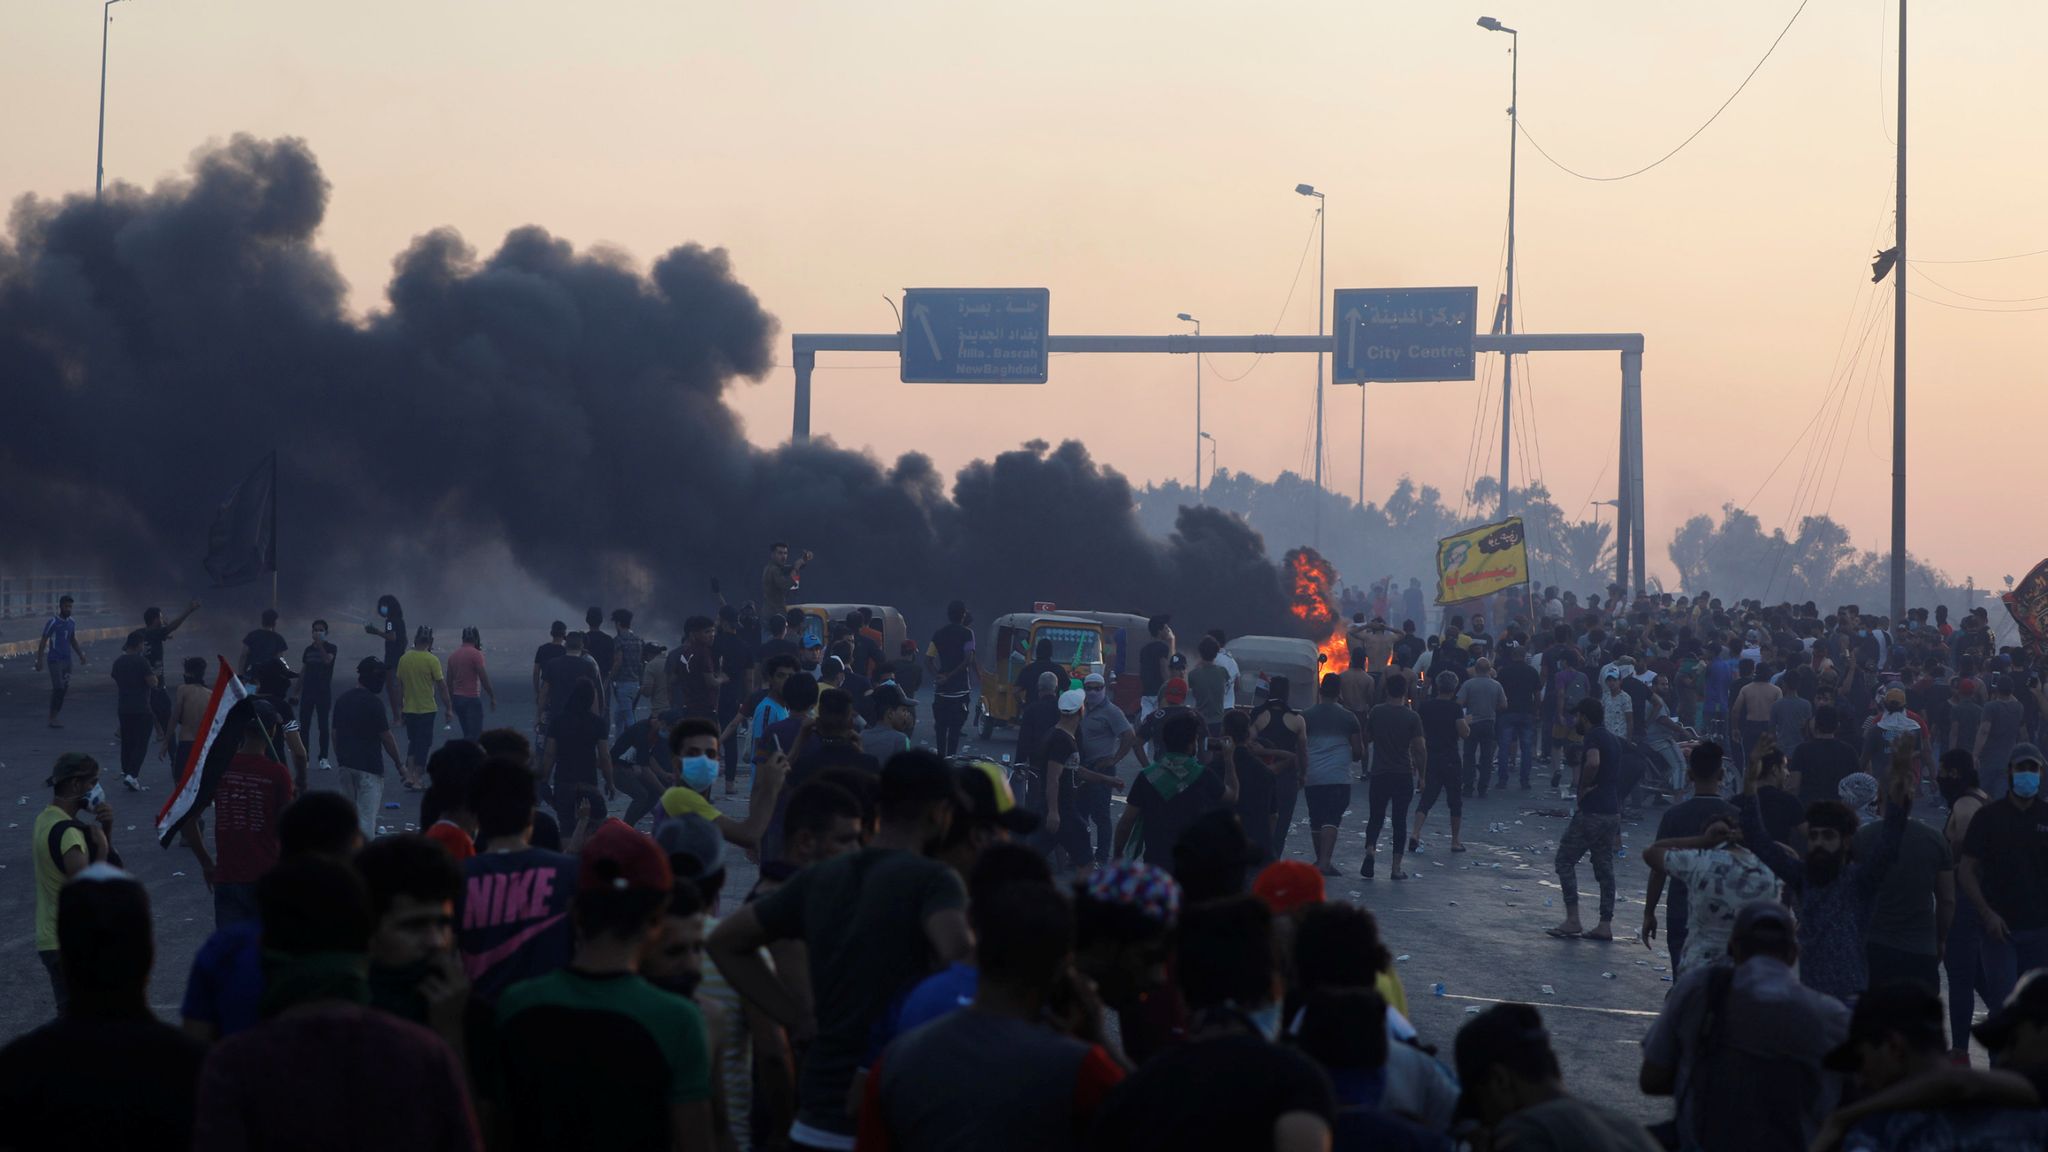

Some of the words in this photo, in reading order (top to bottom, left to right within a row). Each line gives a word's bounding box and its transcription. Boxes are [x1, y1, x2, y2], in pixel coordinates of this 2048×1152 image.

[1370, 305, 1424, 329] المدينة
[1425, 306, 1467, 328] مركز
[957, 326, 1004, 344] الجديدة
[1006, 326, 1039, 344] بغداد
[993, 347, 1038, 359] Basrah
[1367, 344, 1401, 362] City
[387, 621, 393, 631] 8
[462, 866, 557, 931] NIKE
